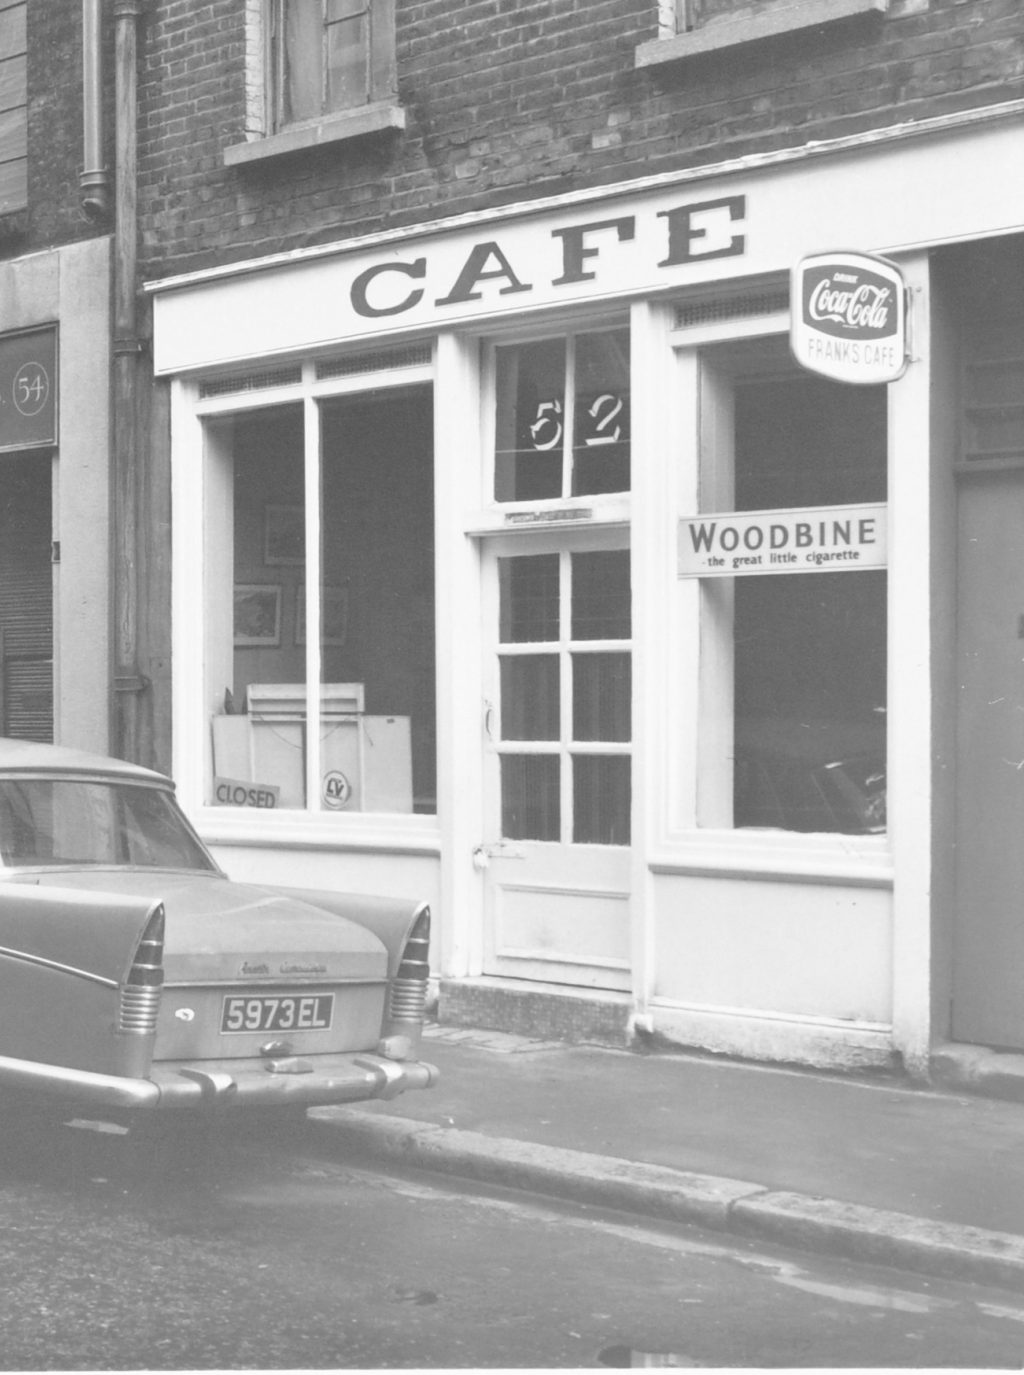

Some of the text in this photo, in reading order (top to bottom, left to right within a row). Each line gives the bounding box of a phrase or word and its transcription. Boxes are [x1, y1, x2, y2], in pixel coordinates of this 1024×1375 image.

[350, 194, 746, 318] CAFE
[809, 278, 890, 329] Coca-Cola
[808, 338, 895, 368] FRANKS CAFE
[19, 374, 44, 403] 54
[530, 394, 623, 452] 52
[689, 519, 877, 554] WOODBINE
[733, 556, 763, 568] great
[770, 553, 797, 564] little
[806, 550, 860, 566] cigarette
[216, 784, 276, 808] CLOSED
